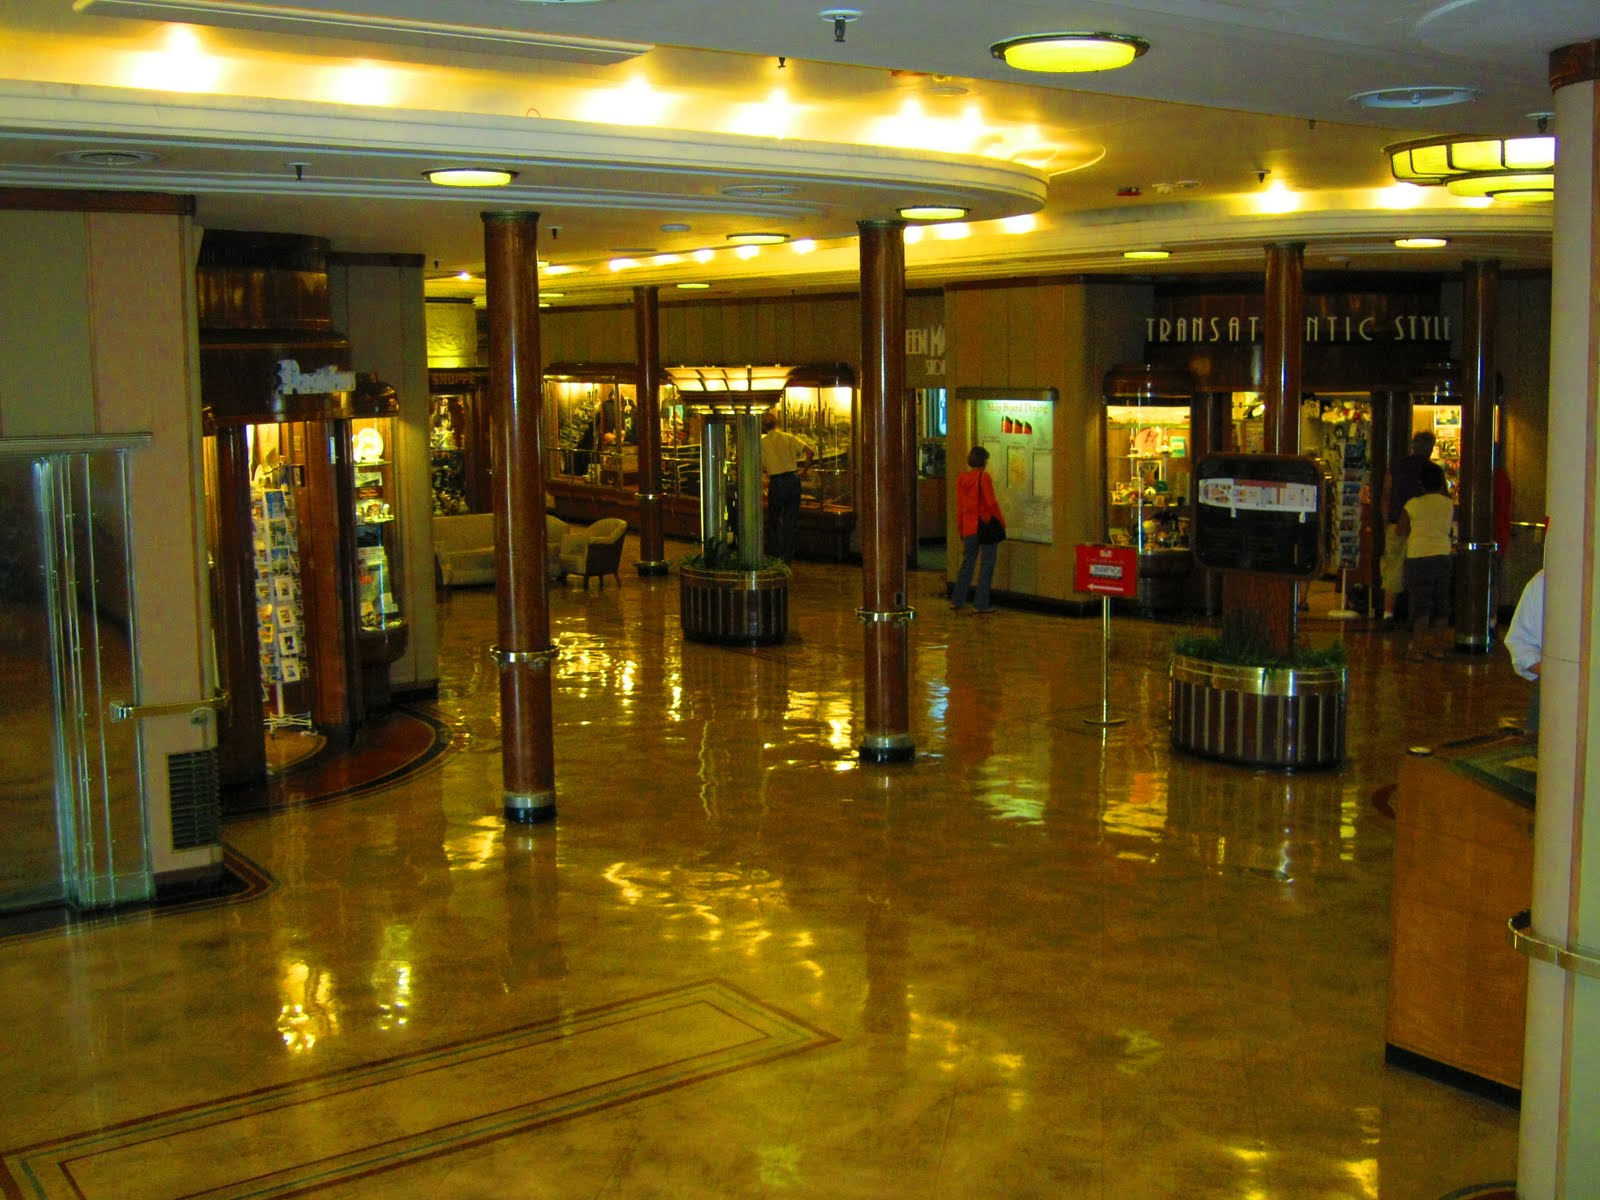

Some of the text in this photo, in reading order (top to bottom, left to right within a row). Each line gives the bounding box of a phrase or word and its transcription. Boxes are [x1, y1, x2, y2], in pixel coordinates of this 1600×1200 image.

[1145, 315, 1452, 342] TRANSATNTIC STYLE
[905, 329, 928, 355] EEN
